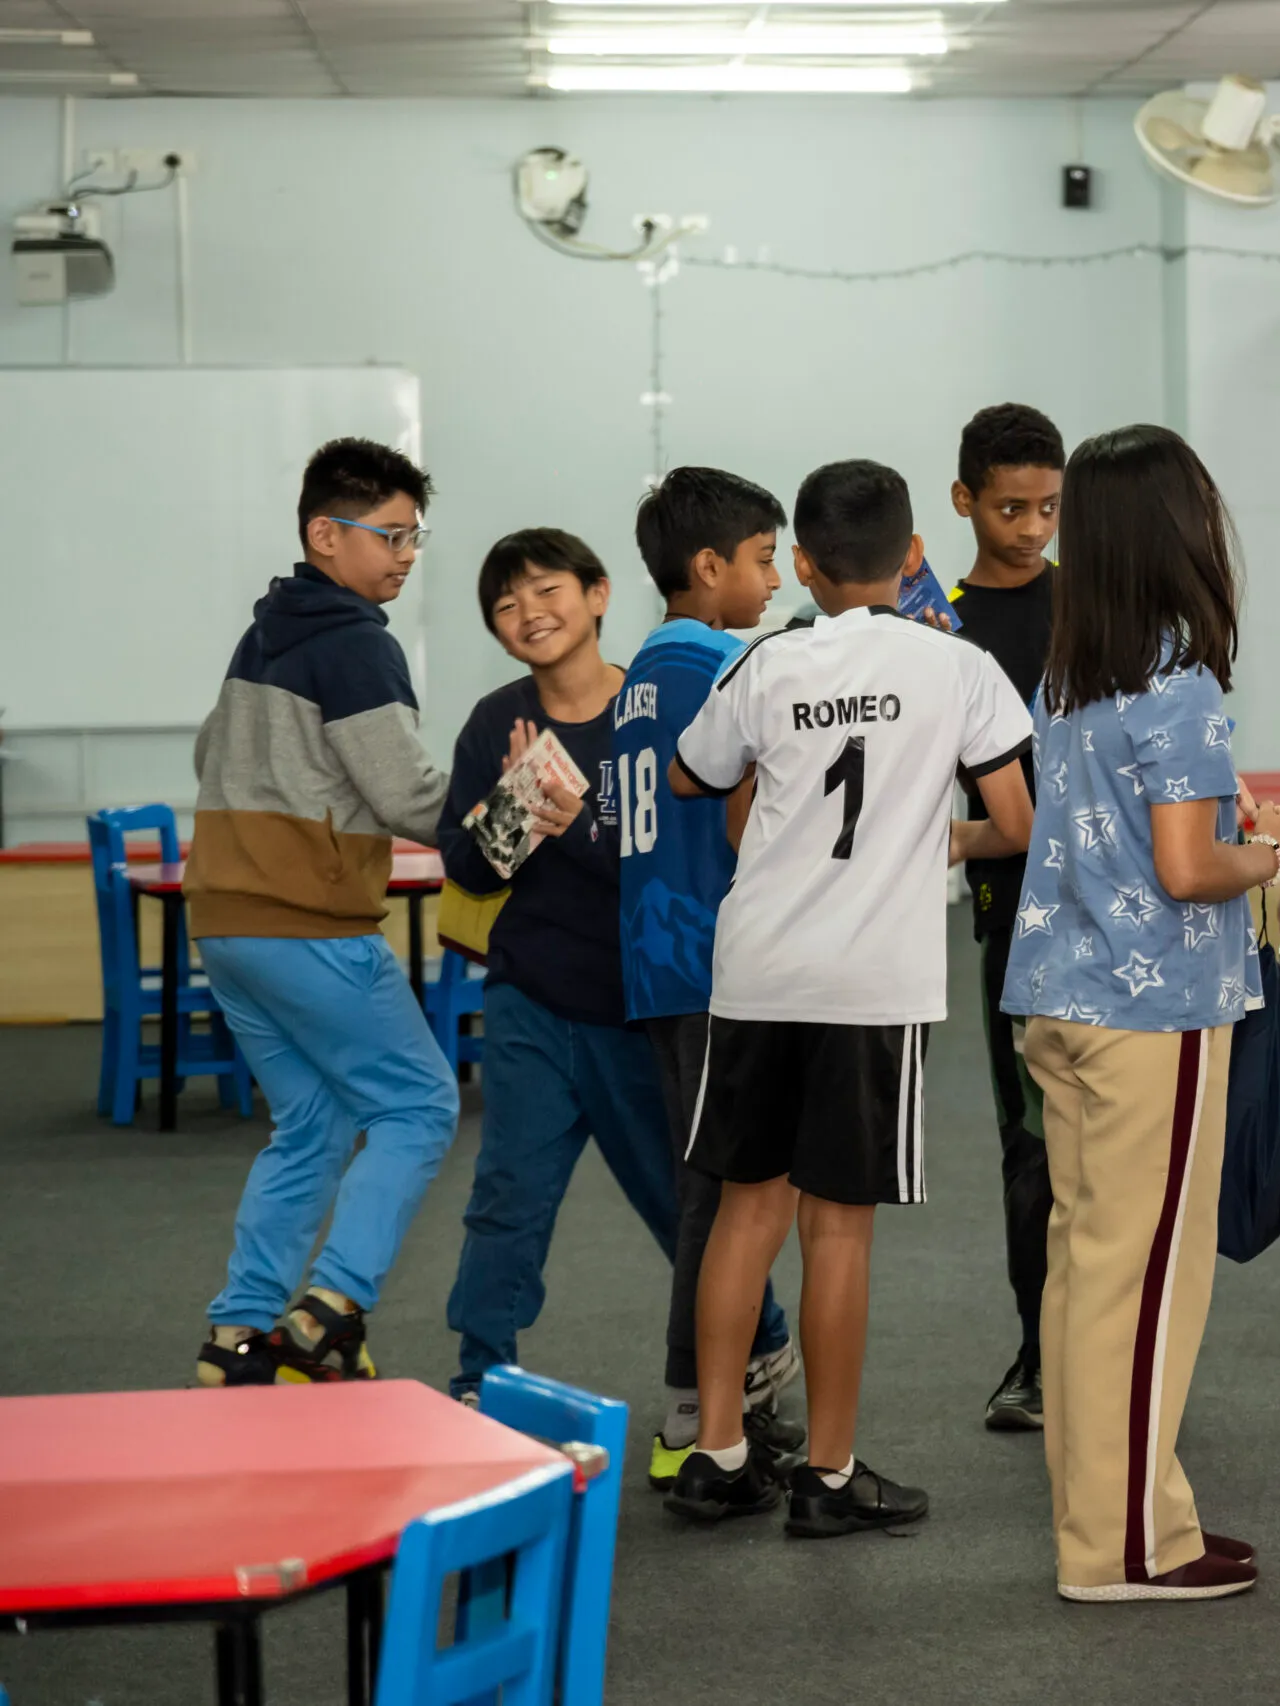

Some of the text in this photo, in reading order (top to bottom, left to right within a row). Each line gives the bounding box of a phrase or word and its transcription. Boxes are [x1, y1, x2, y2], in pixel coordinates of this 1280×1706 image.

[615, 683, 658, 731] LAKSH
[792, 693, 901, 731] ROMEO
[618, 747, 658, 858] 18
[824, 736, 865, 860] 1
